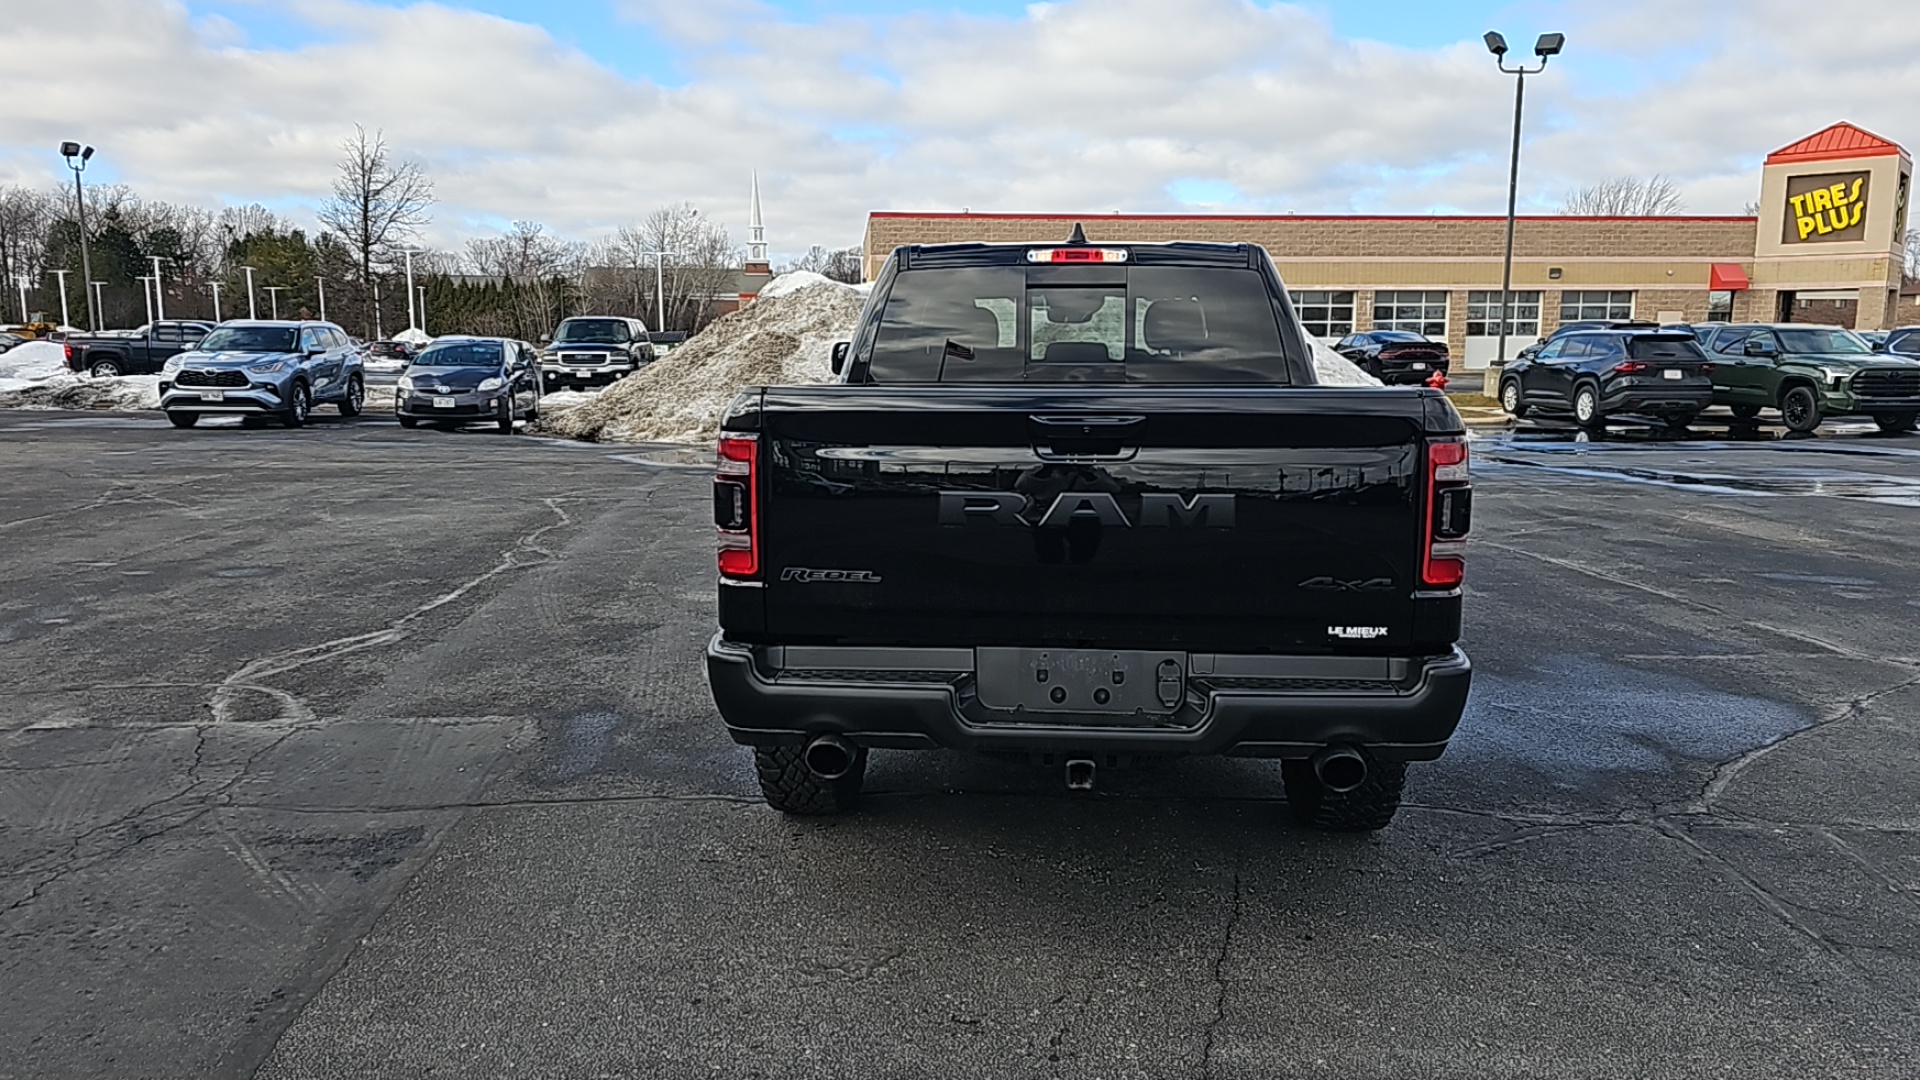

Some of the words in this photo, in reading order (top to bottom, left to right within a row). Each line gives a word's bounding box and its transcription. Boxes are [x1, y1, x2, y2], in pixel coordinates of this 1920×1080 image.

[1789, 177, 1863, 217] TIRES
[1797, 200, 1864, 240] PLUS
[938, 490, 1236, 528] RAM
[780, 567, 882, 582] REBEL
[1327, 626, 1344, 635] LE
[1346, 626, 1388, 635] MIEUX
